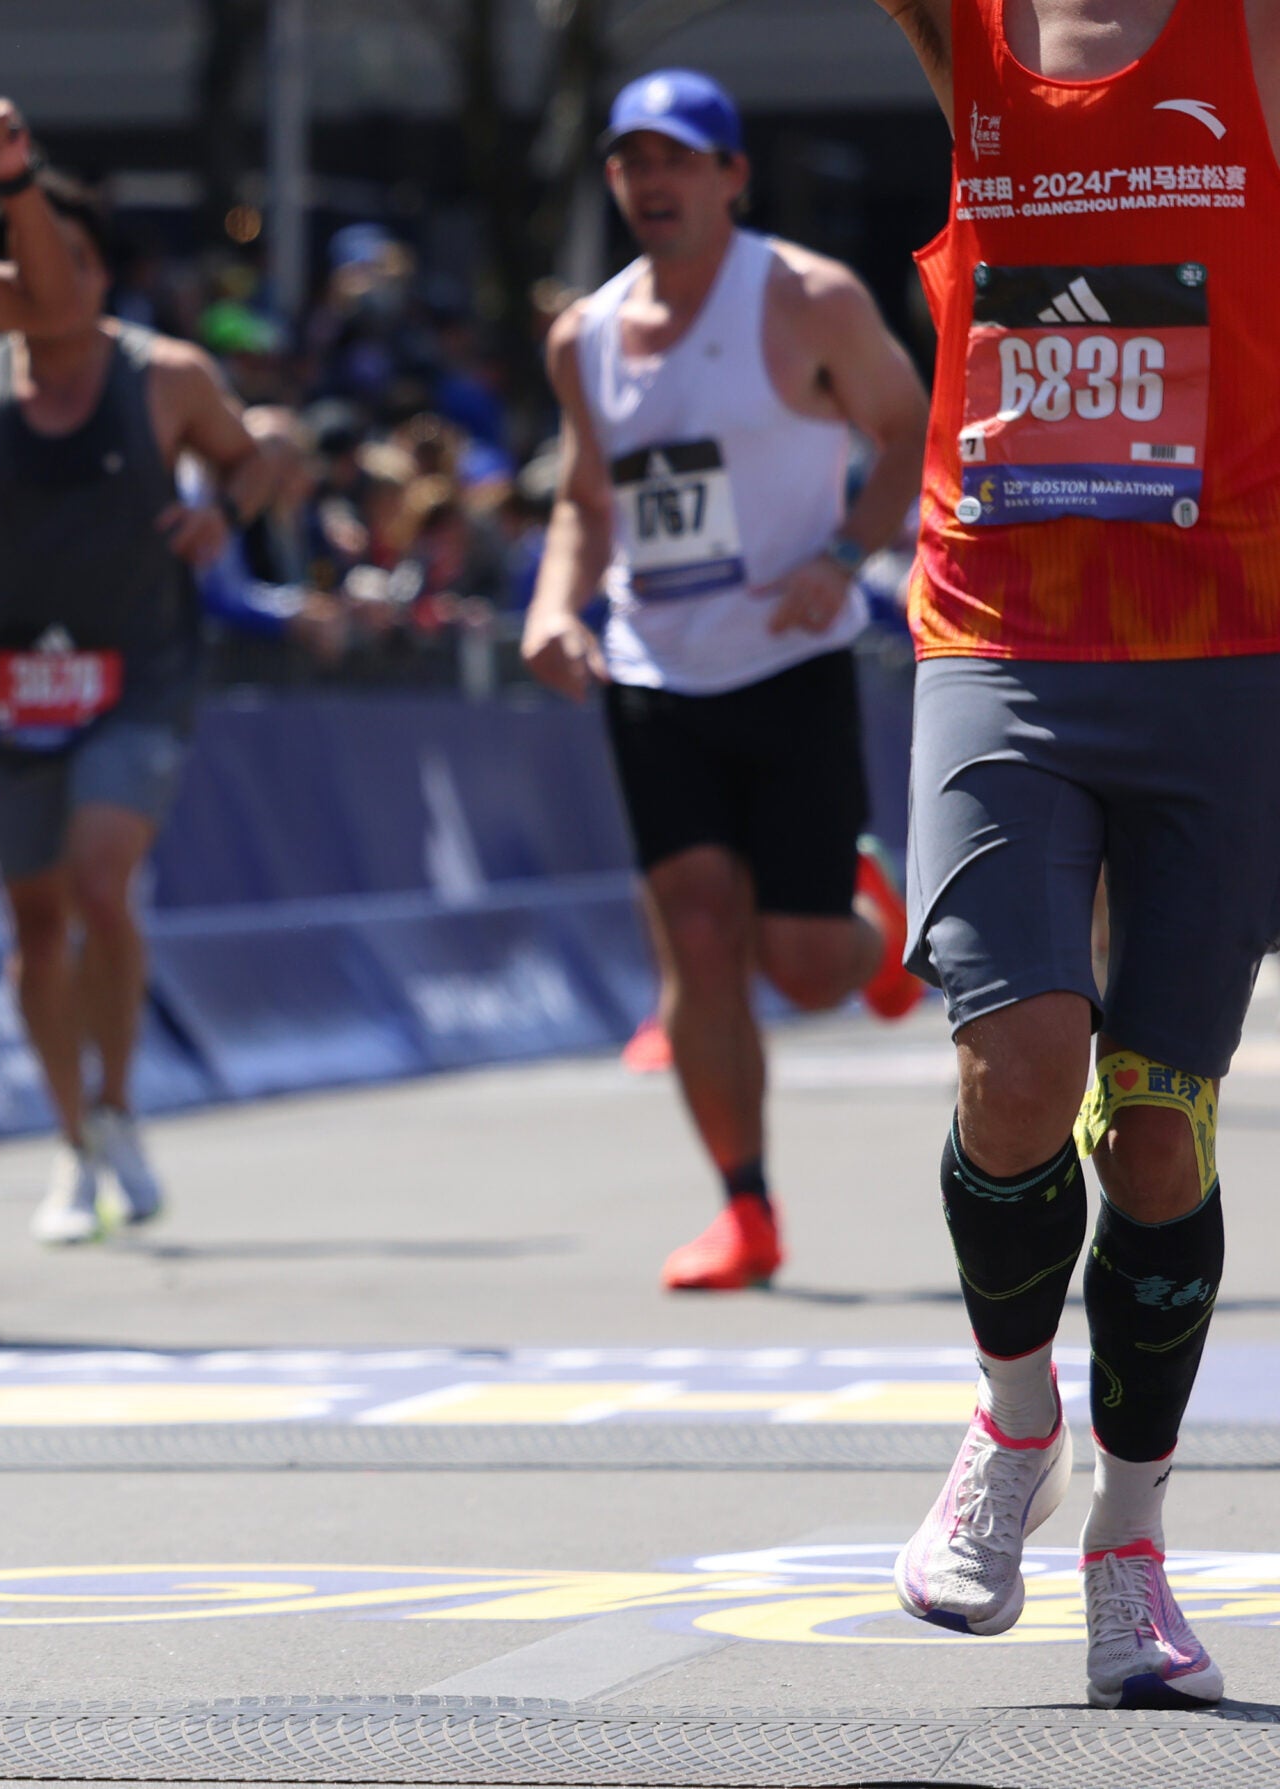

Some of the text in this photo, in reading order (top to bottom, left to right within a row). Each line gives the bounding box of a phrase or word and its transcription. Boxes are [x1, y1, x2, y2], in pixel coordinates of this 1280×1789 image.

[1033, 165, 1246, 199] 2024广州马拉松赛
[1022, 197, 1118, 216] GUANGZHOU
[1120, 193, 1212, 209] MARATHON
[1213, 194, 1246, 208] 2024
[998, 335, 1165, 422] 6836
[1032, 480, 1088, 494] BOSTON
[1090, 480, 1175, 497] MARATHON
